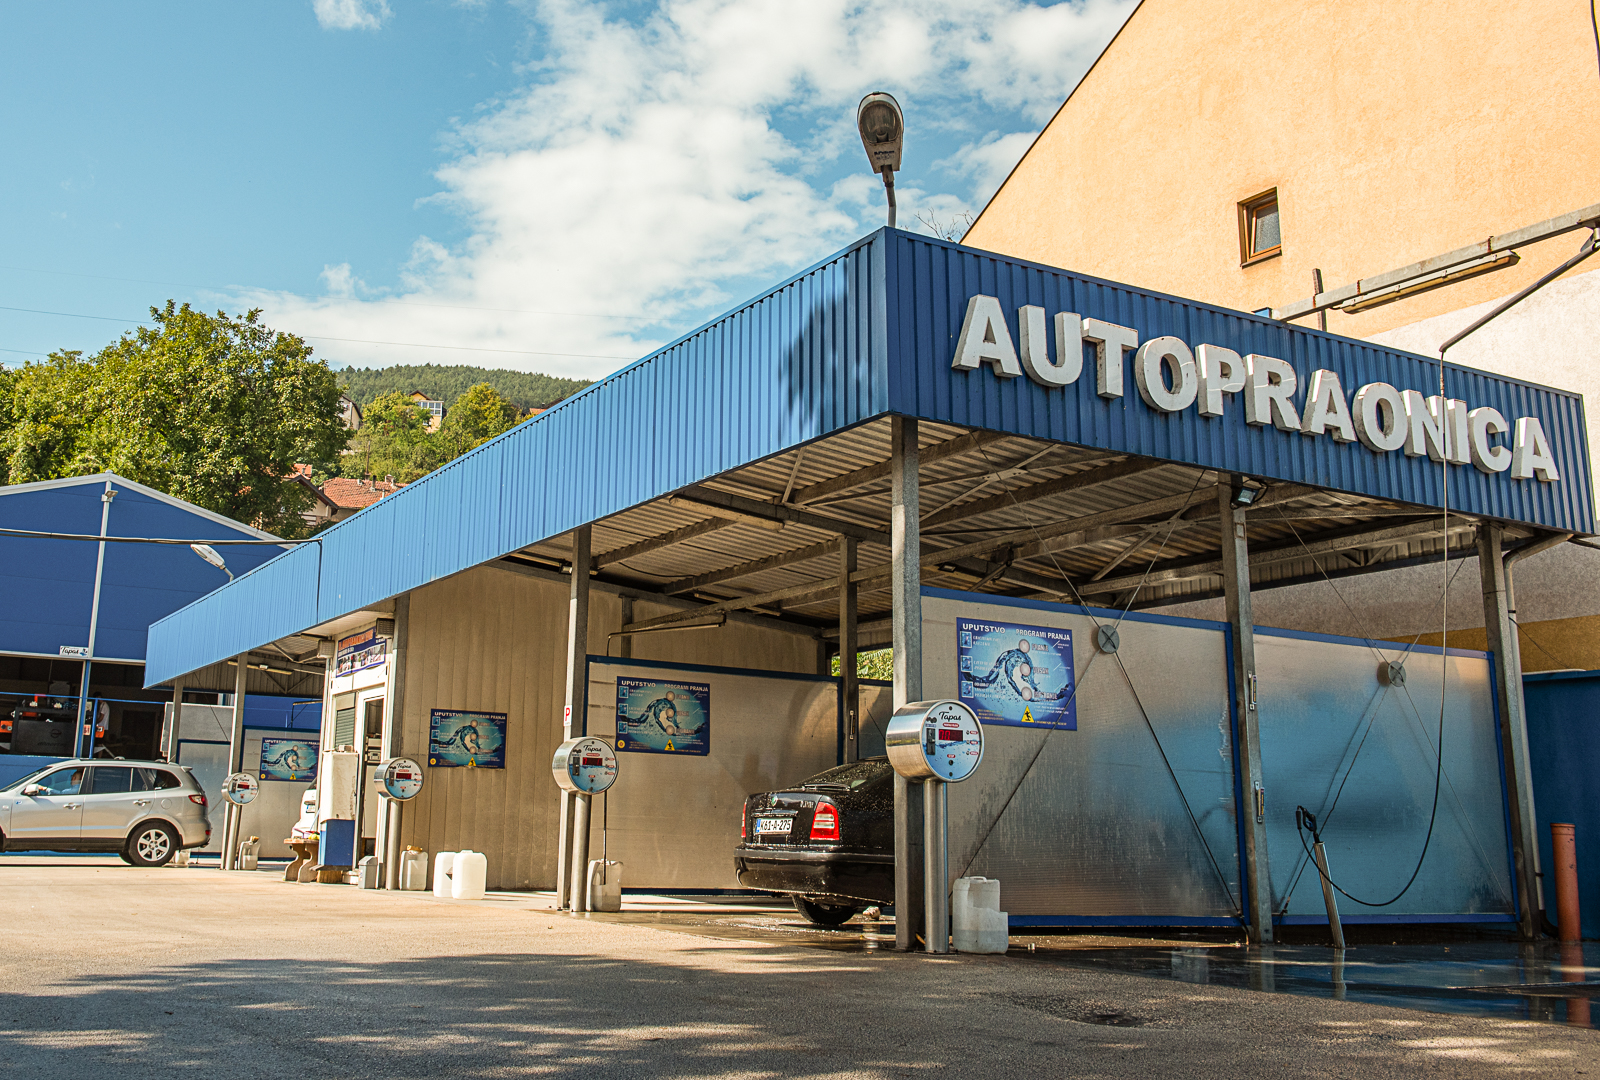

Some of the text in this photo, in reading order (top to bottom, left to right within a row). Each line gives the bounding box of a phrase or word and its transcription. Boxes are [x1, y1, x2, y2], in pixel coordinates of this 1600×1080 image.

[951, 294, 1559, 481] AUTOPRAONICA
[962, 623, 1006, 634] UPUTSTVO
[1015, 629, 1070, 641] PROGRAMI PRANJA
[621, 680, 656, 688] UPUTSTVO
[565, 707, 571, 721] P
[939, 711, 962, 722] Tapas
